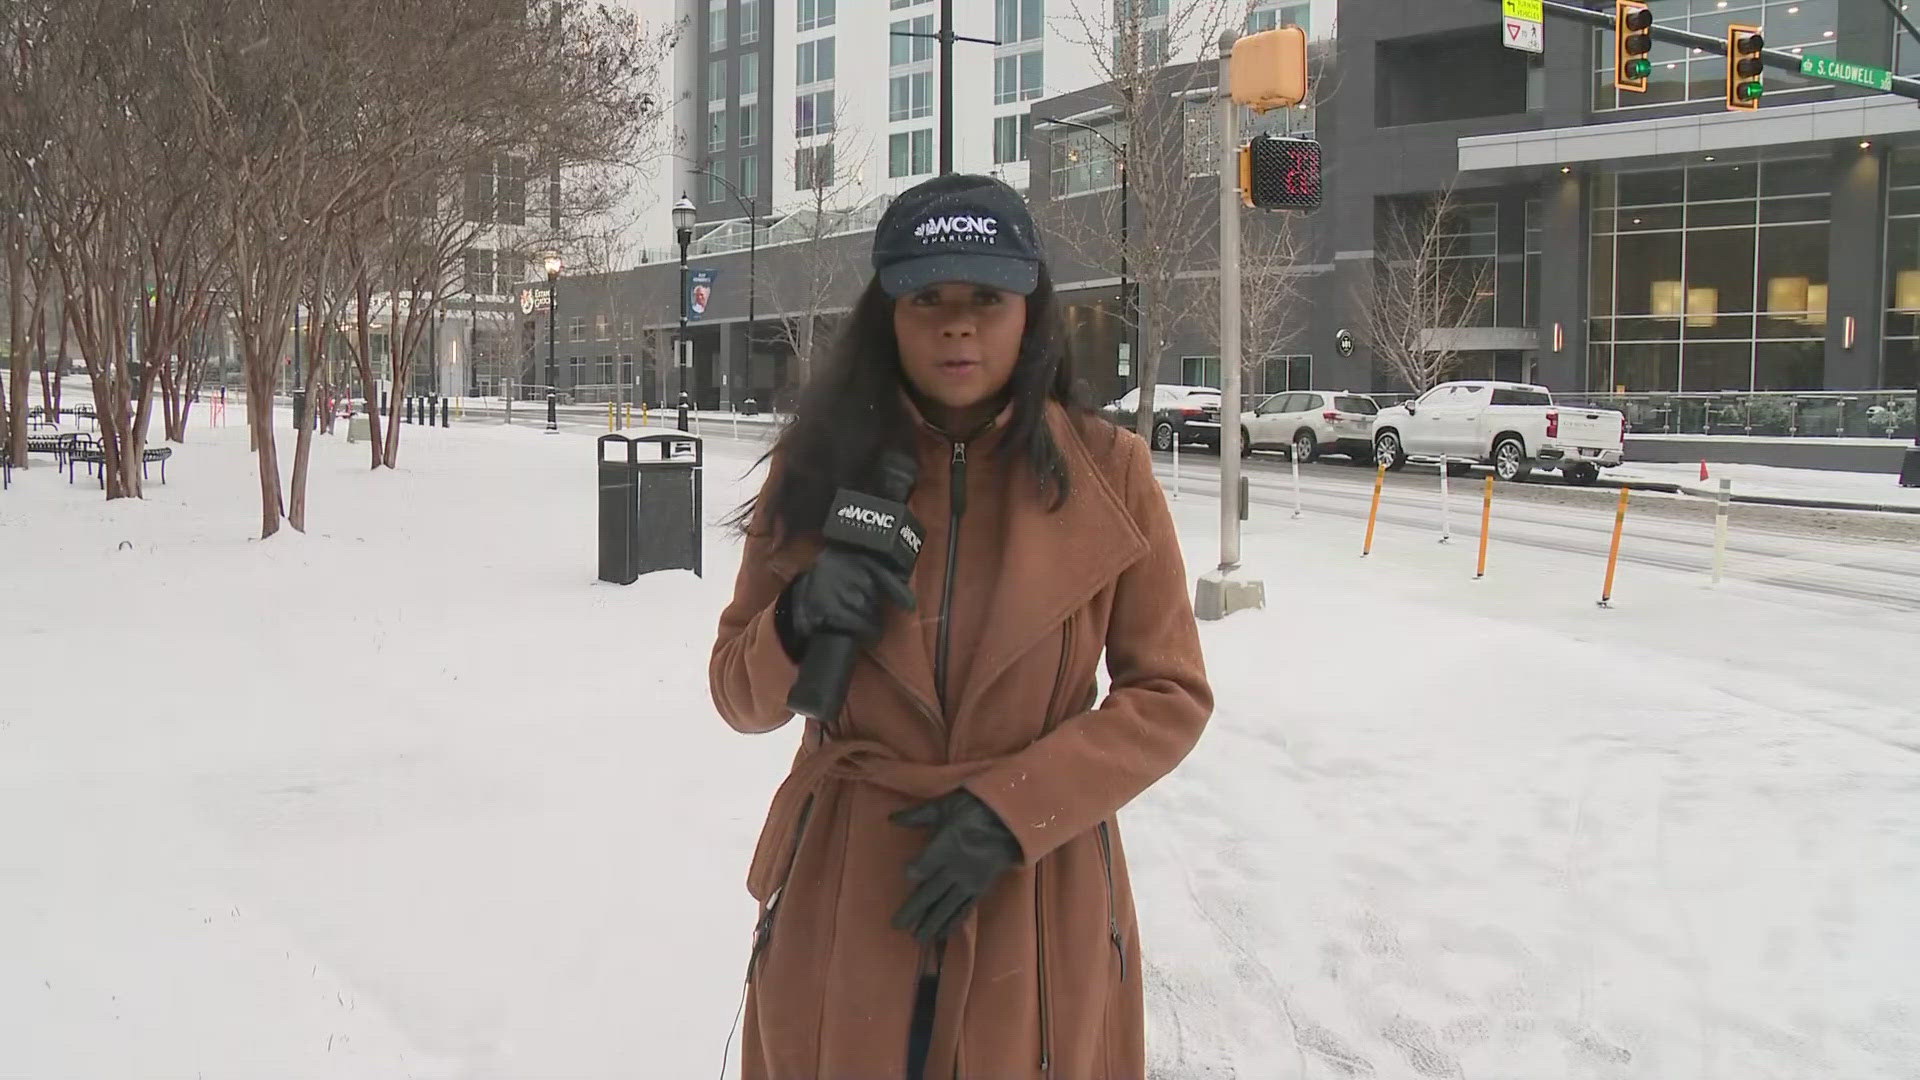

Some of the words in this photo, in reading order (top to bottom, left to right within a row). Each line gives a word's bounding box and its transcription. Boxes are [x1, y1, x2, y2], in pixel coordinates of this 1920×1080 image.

[1818, 60, 1826, 76] S.
[1828, 62, 1874, 85] CALDWELL
[929, 215, 998, 236] WCNC
[921, 234, 996, 246] CHARLOTTE
[847, 504, 895, 529] WCNC
